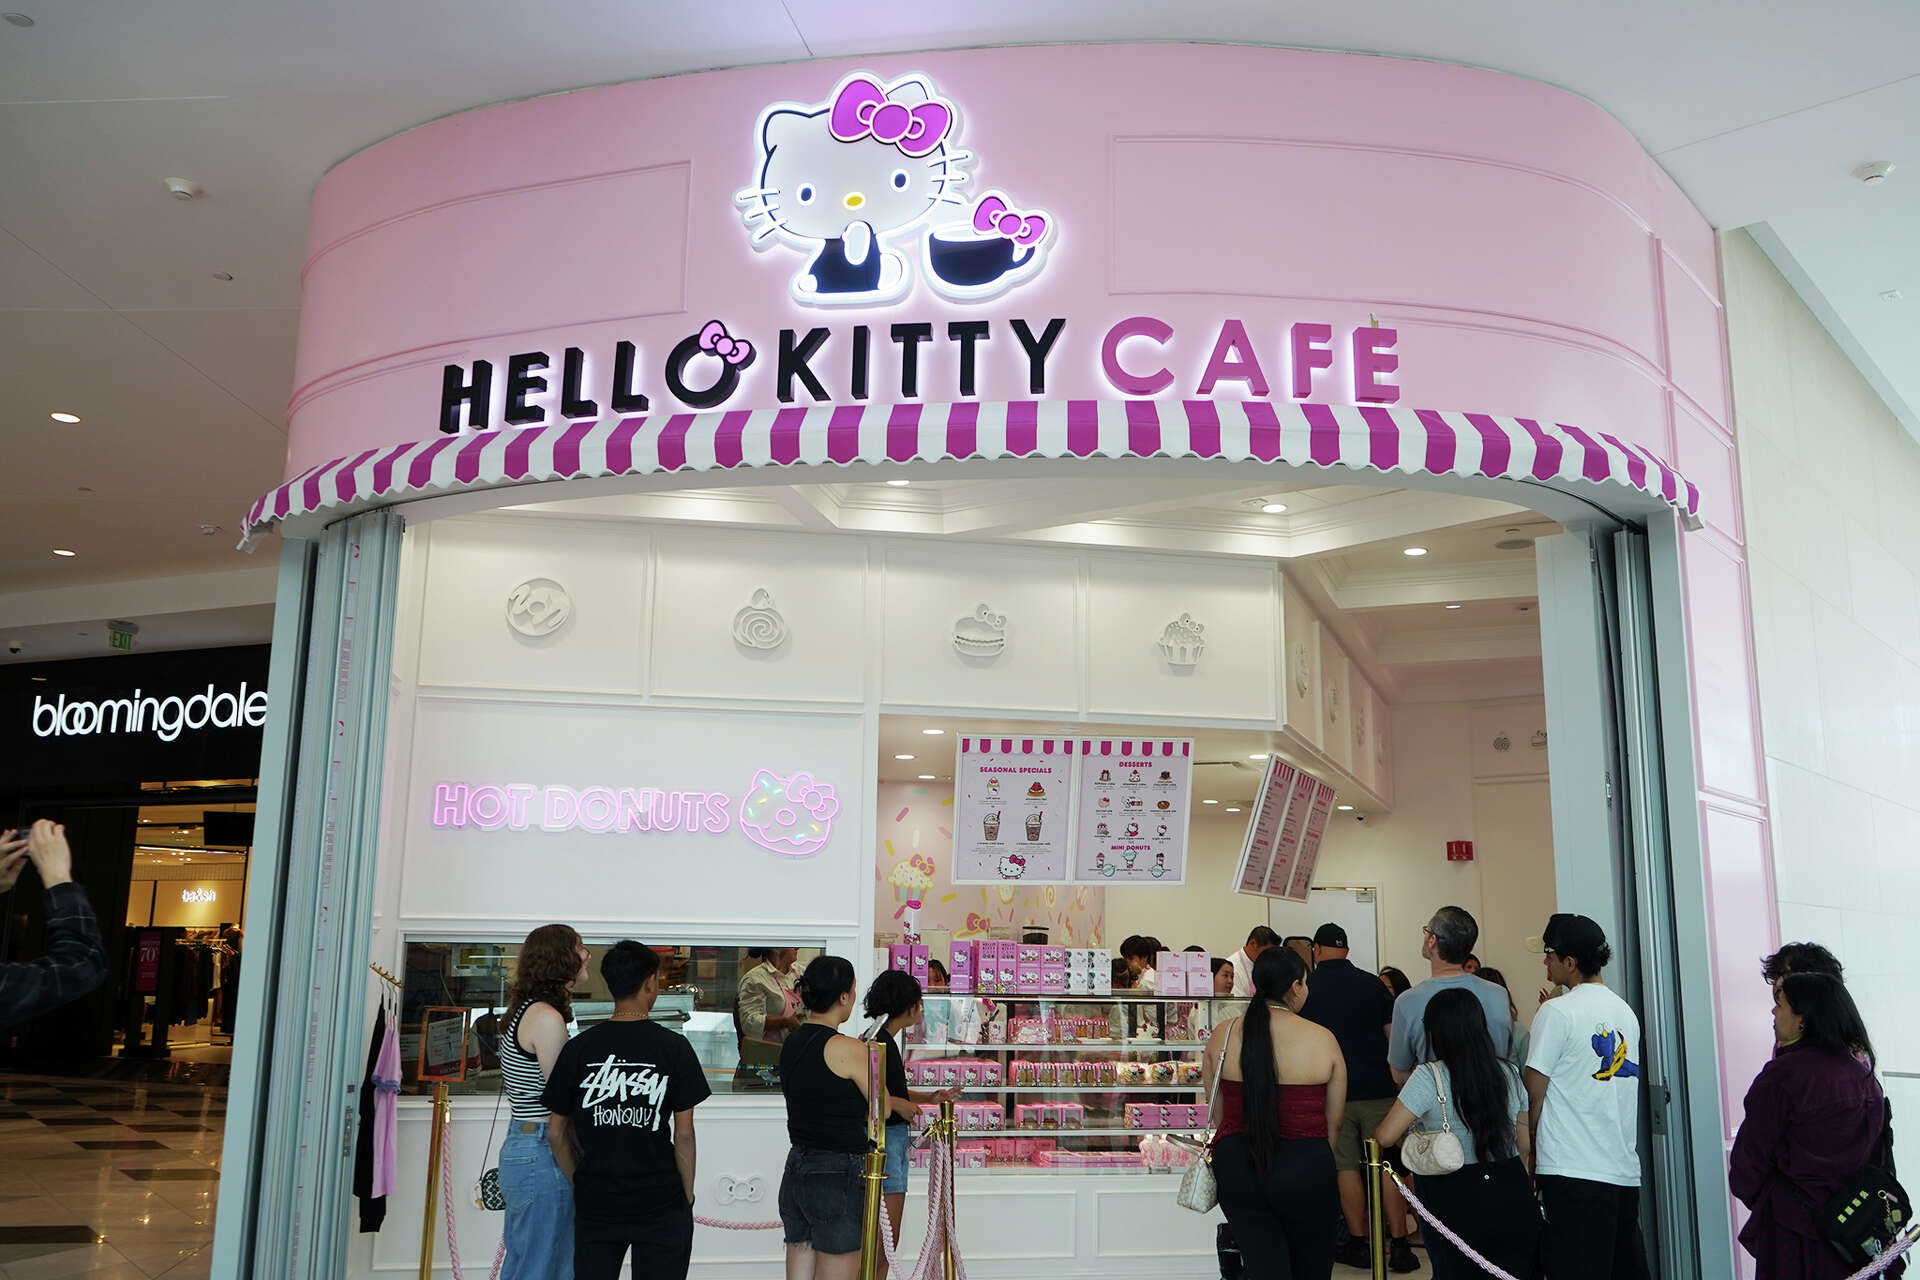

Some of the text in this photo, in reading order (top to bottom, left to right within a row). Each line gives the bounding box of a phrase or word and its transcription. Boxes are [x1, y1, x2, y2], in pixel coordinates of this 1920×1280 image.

[439, 316, 1400, 434] HELLO KITTY CAFE
[111, 631, 134, 649] EXIT
[433, 784, 731, 834] HOT DONUTS
